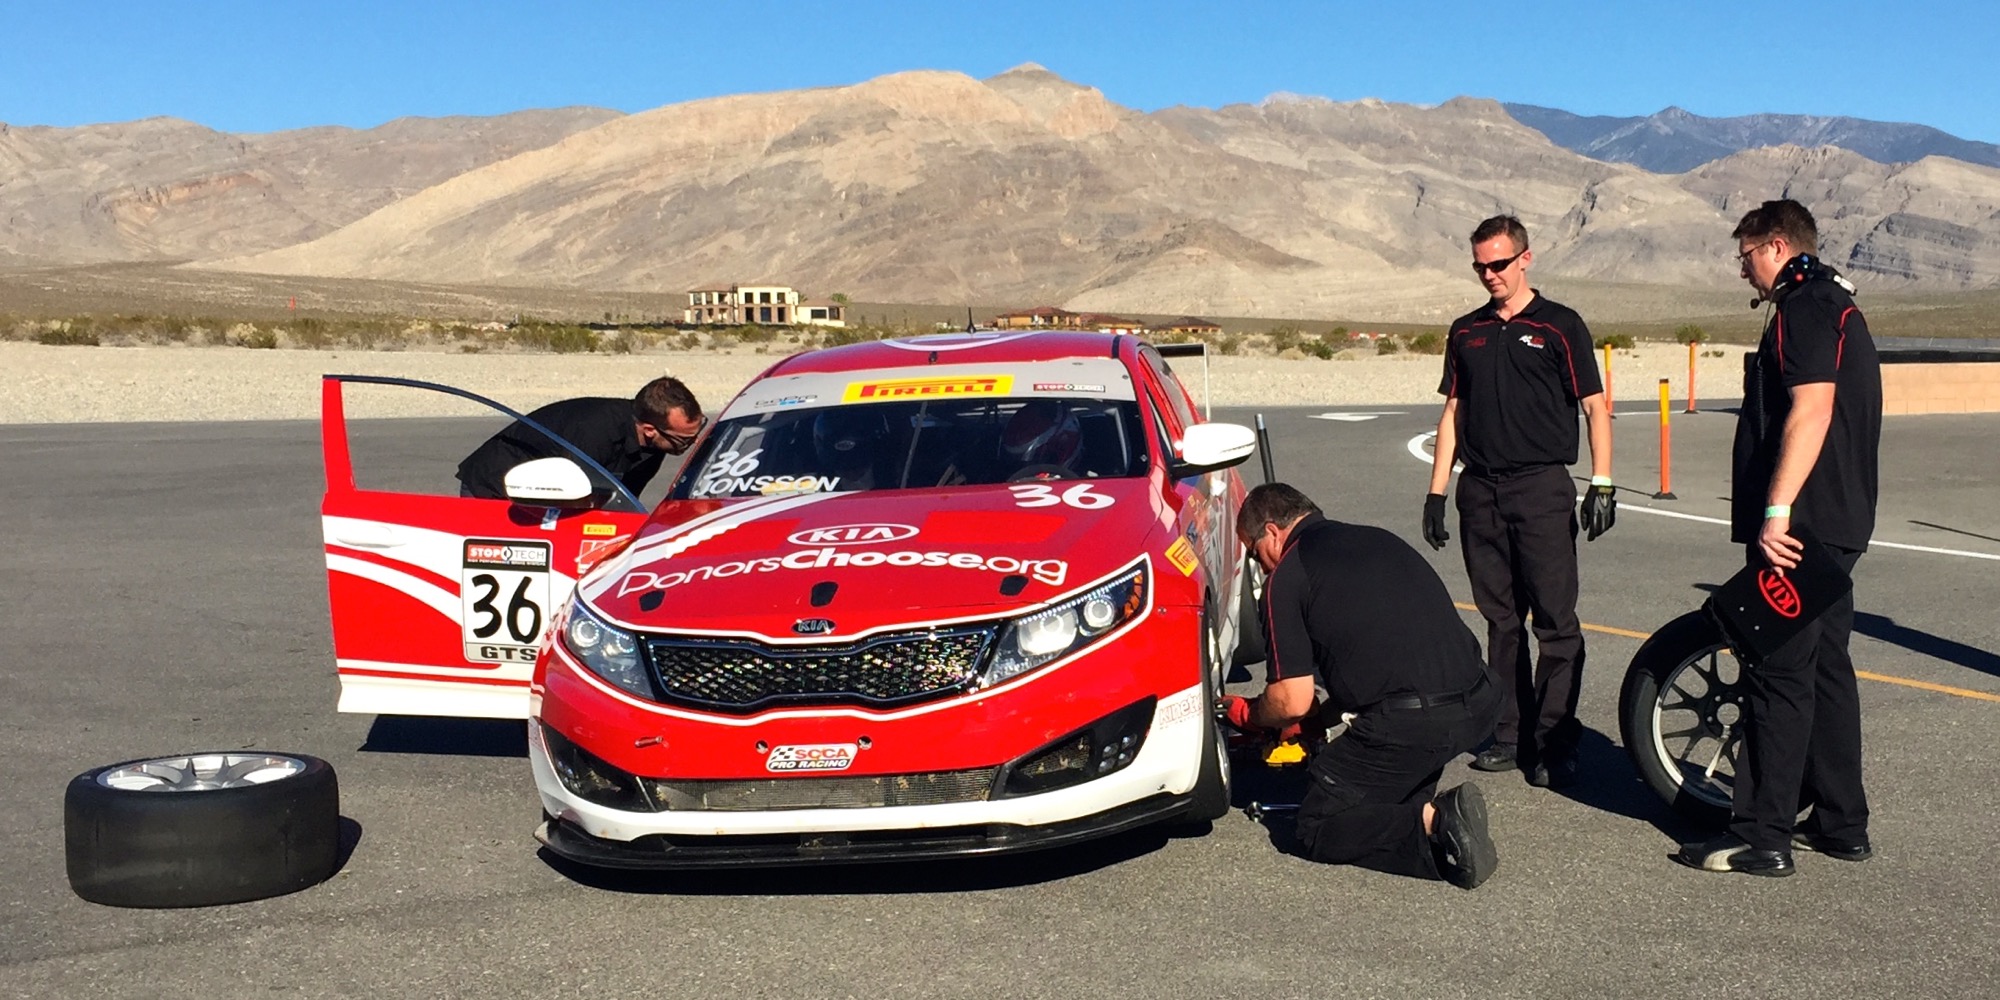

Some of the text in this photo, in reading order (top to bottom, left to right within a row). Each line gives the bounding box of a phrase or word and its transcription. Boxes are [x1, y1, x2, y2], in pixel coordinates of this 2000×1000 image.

[859, 378, 998, 397] PIRELLI
[703, 448, 764, 480] 36
[692, 475, 841, 497] JONSSON
[1007, 483, 1116, 510] 36
[809, 525, 896, 543] KIA
[470, 547, 545, 560] STOP TECH
[616, 549, 1068, 598] DonorsChoose.org
[1765, 574, 1795, 611] KIA
[471, 573, 542, 645] 36
[797, 619, 830, 632] KIA
[480, 645, 537, 662] GTS
[794, 747, 849, 760] SCCA
[769, 760, 848, 769] PRO RACING
